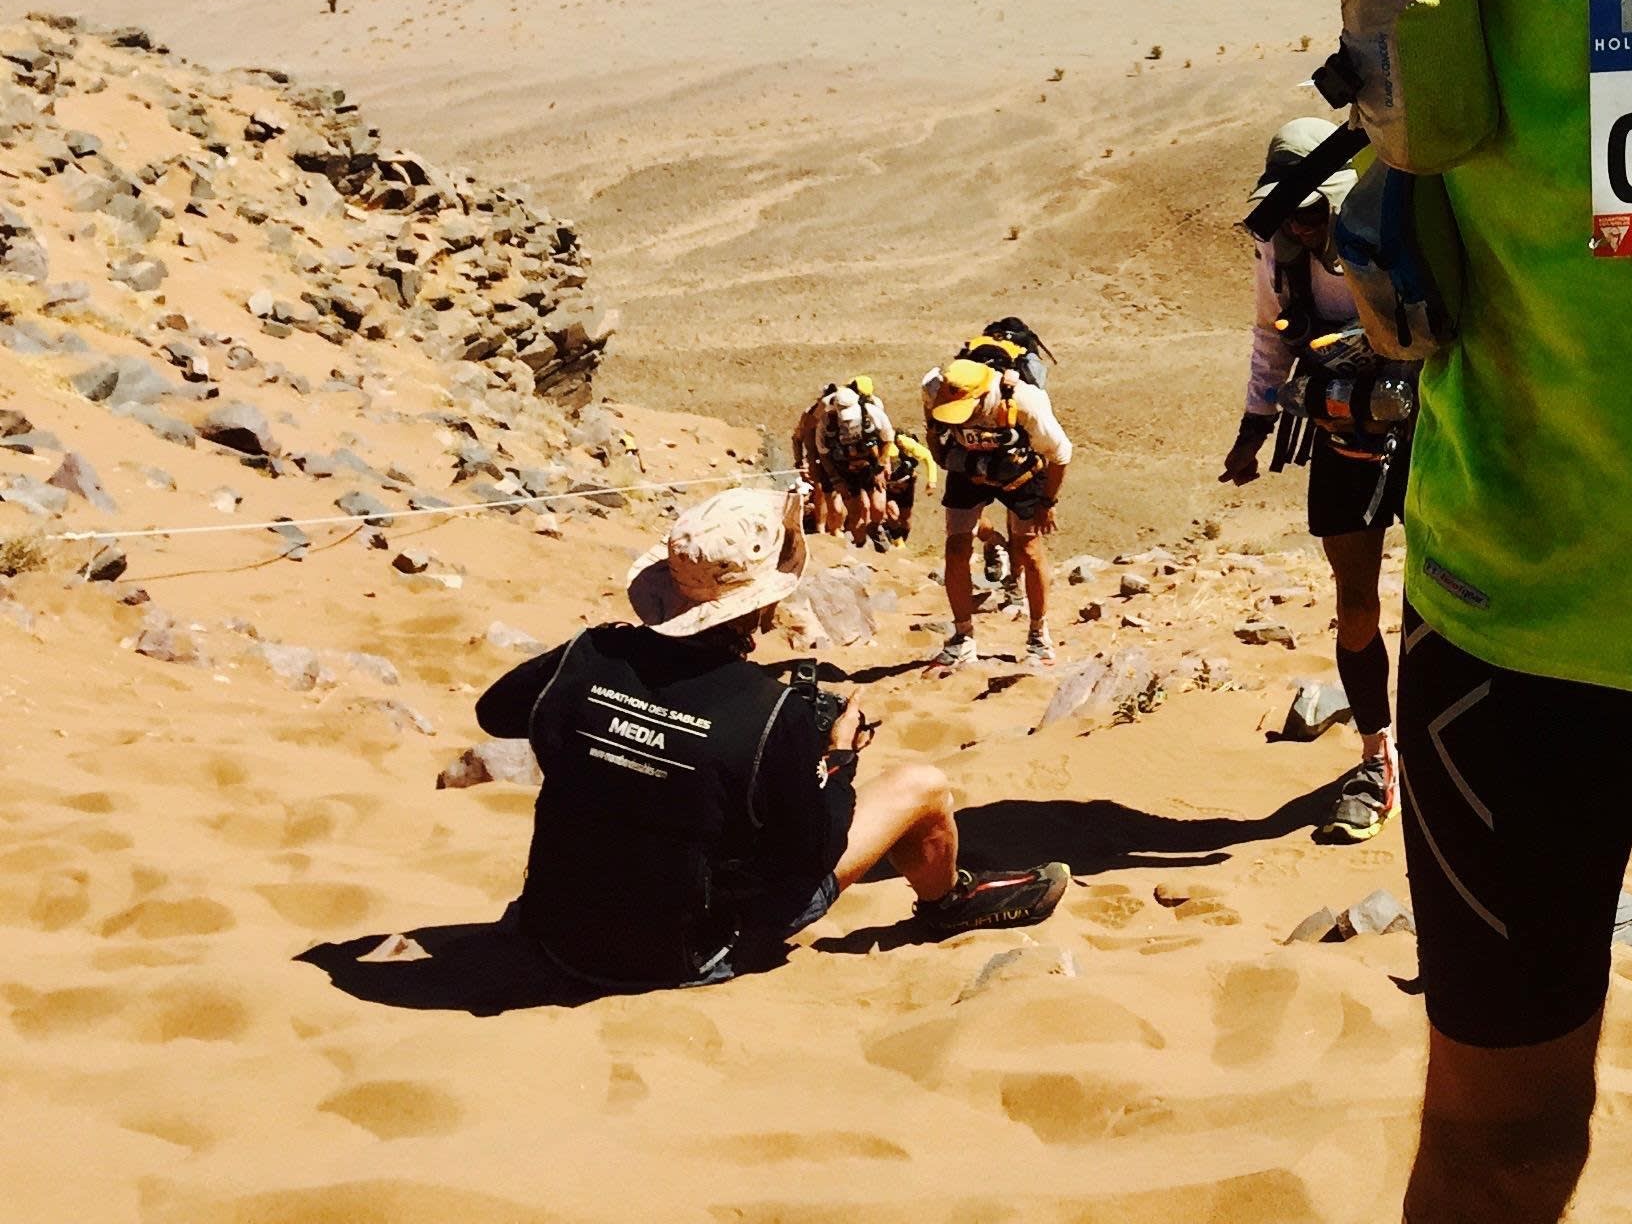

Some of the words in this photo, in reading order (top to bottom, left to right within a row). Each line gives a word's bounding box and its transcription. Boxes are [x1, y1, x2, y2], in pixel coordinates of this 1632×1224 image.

[590, 684, 647, 711] MARATHON
[649, 703, 669, 718] DES
[668, 710, 712, 730] SABLES
[608, 717, 665, 750] MEDIA
